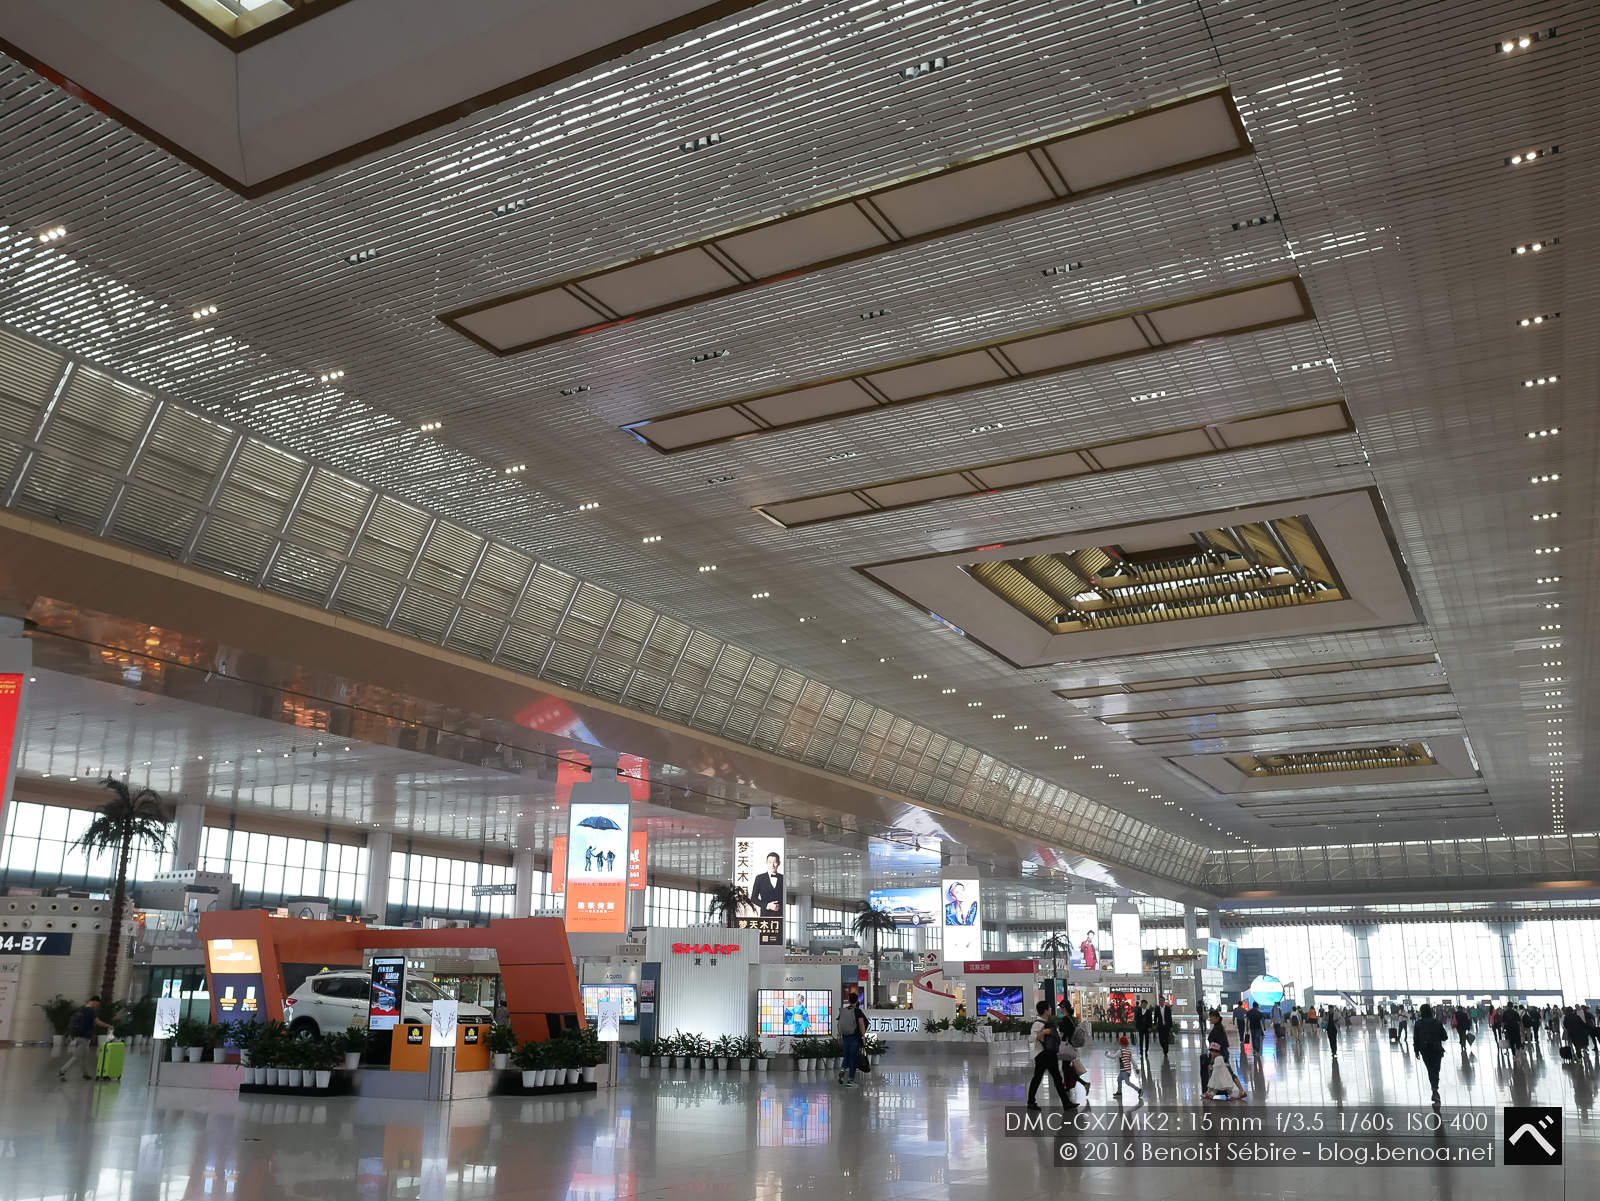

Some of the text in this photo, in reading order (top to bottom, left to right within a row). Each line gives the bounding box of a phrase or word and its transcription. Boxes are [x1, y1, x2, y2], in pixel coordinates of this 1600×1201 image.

[672, 943, 740, 955] SHARP
[867, 1016, 919, 1033] 江苏卫视
